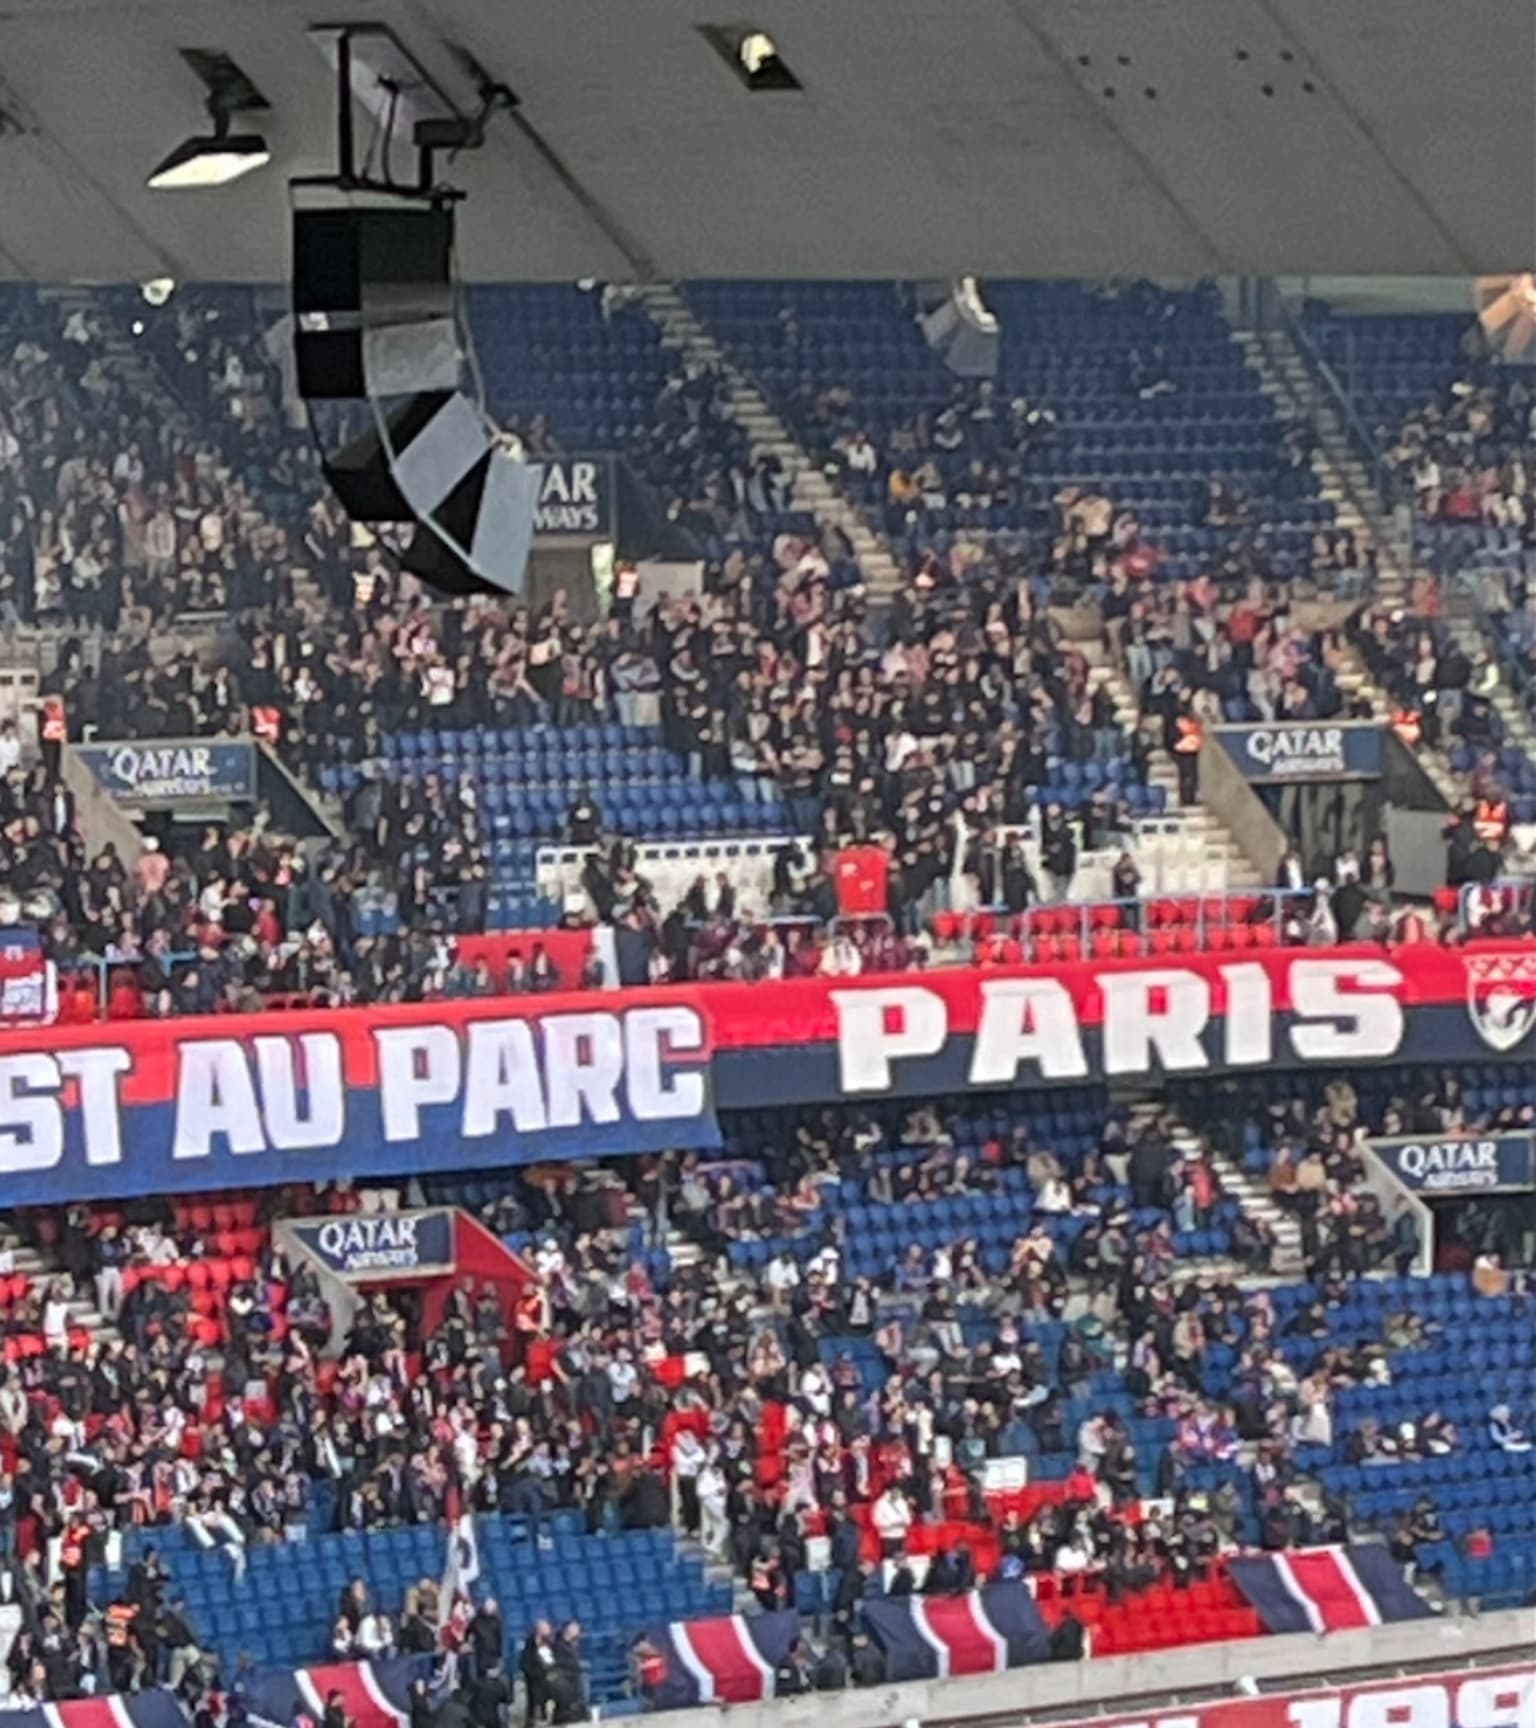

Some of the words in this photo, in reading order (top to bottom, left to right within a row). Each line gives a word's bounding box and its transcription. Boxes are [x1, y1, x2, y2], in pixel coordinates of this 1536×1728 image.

[113, 746, 212, 785] QATAR
[1246, 728, 1344, 764] QATAR
[830, 959, 1403, 1092] PARIS
[173, 1031, 345, 1161] AU
[376, 1006, 703, 1142] PARC
[1398, 1142, 1497, 1178] QATAR
[318, 1216, 416, 1258] QATAR
